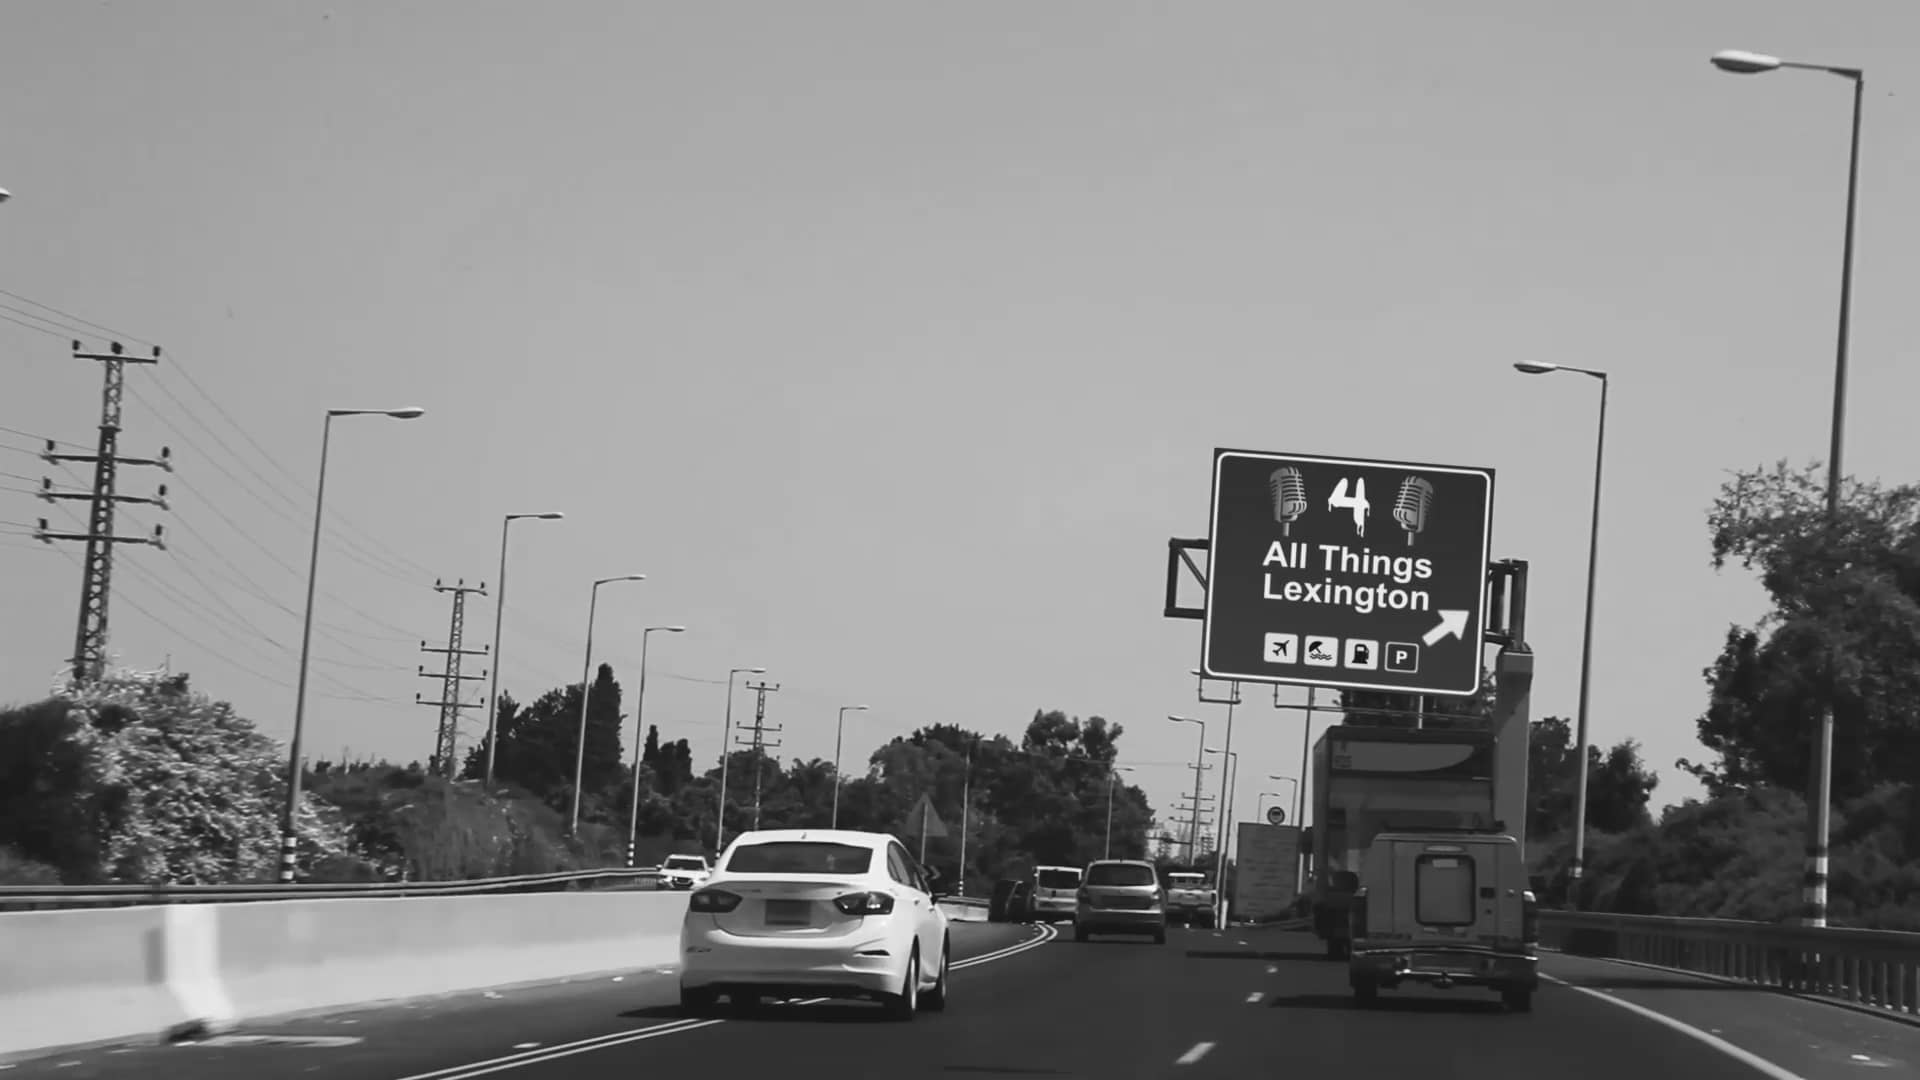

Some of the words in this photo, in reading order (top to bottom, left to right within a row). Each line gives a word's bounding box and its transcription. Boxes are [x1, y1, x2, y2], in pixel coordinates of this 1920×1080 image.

[1328, 477, 1370, 538] 4
[1262, 541, 1308, 569] All
[1318, 544, 1433, 584] Things
[1263, 573, 1430, 614] Lexington
[1395, 650, 1408, 664] P
